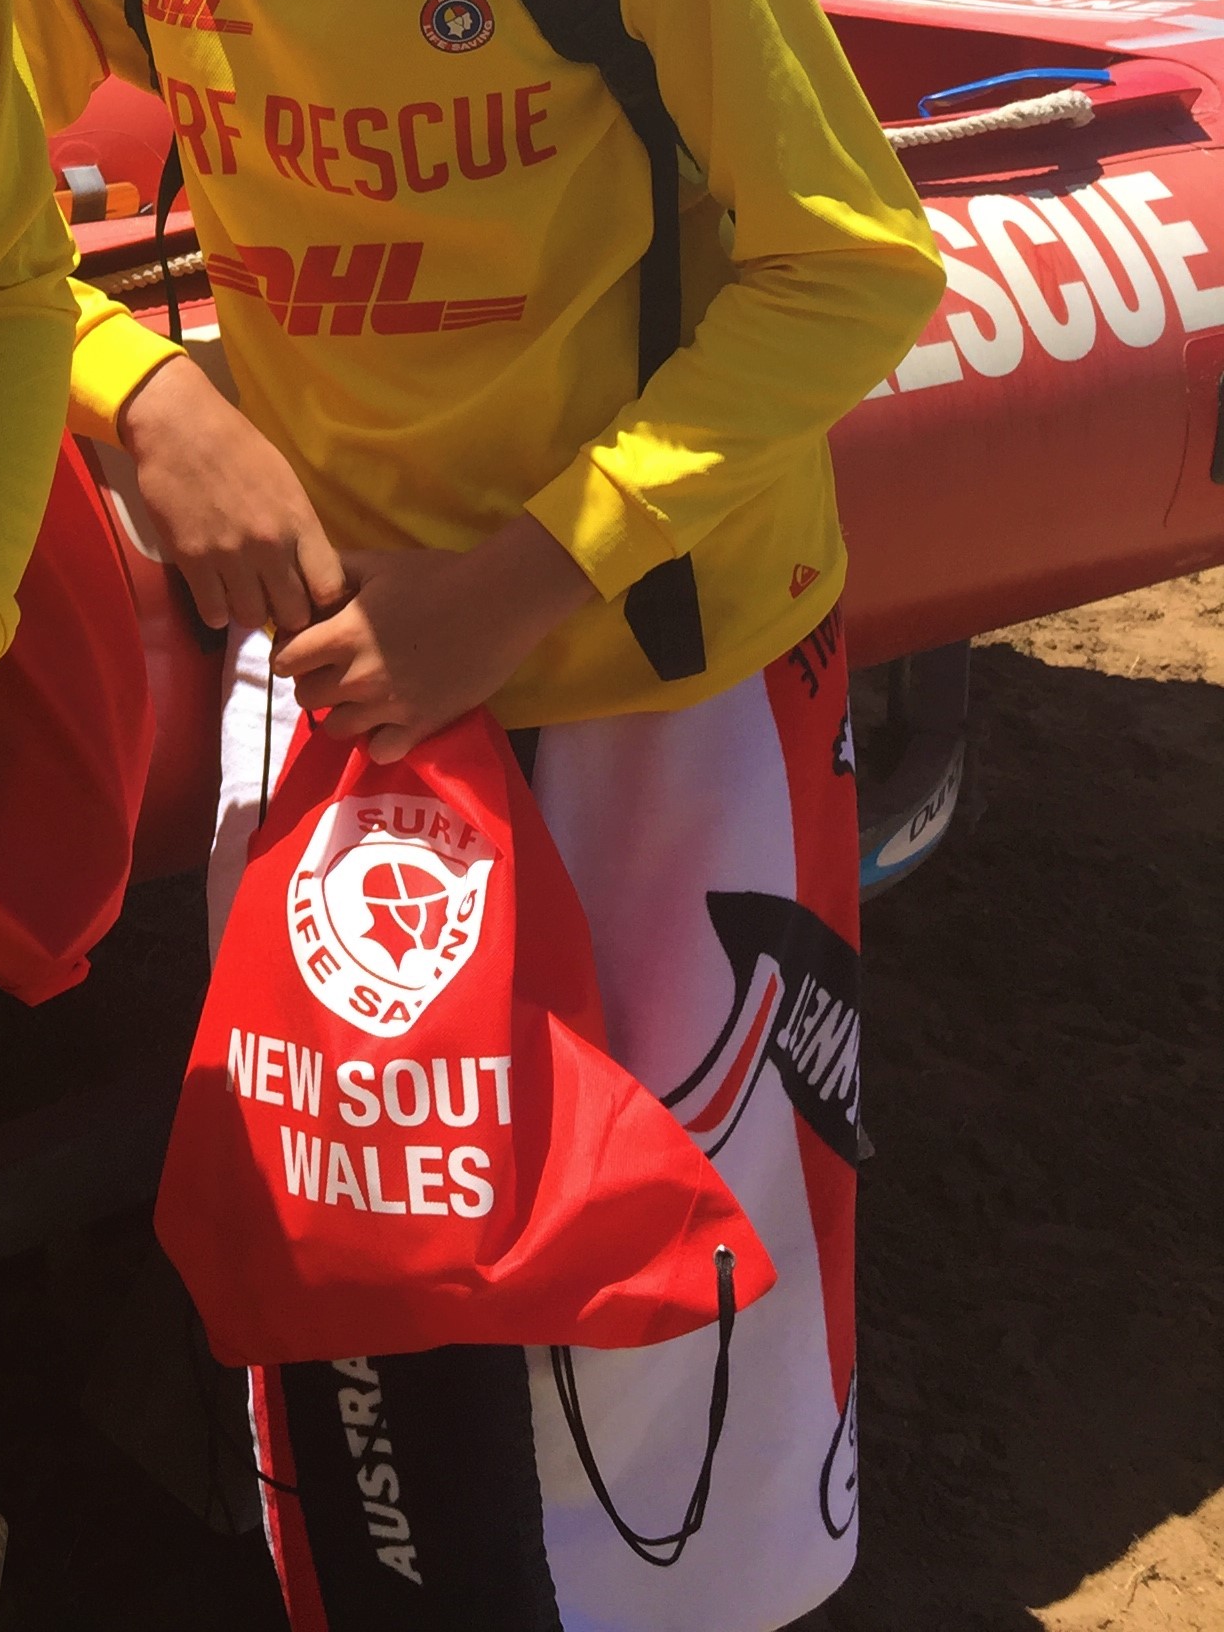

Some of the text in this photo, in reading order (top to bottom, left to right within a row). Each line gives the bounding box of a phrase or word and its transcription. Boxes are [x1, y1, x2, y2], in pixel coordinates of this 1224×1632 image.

[423, 20, 493, 51] LIFE SAVING
[159, 73, 558, 201] RF RESCUE
[235, 241, 446, 337] DHL
[357, 806, 479, 850] SURF
[294, 871, 477, 1024] LIFE SANG
[226, 1027, 324, 1118] NEW
[279, 1125, 495, 1219] WALES
